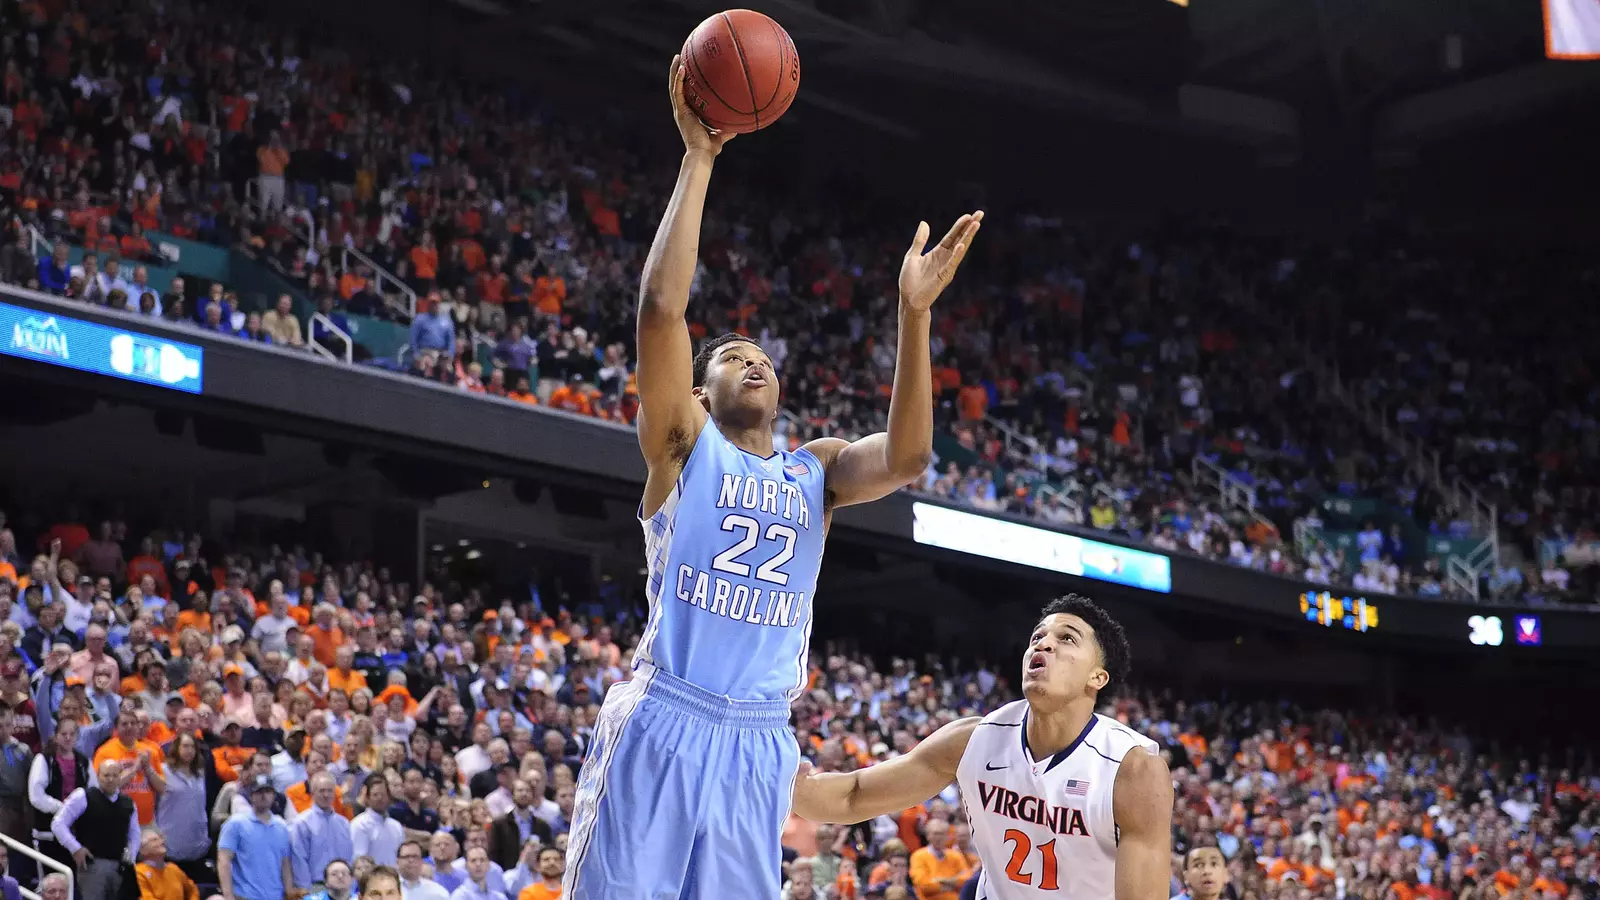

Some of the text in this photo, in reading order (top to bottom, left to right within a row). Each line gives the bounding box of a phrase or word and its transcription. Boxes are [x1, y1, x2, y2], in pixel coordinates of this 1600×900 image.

[716, 473, 810, 530] NORTH
[711, 513, 798, 586] 22
[675, 563, 805, 627] CAROLINA
[977, 780, 1091, 838] VIRGINIA
[1003, 828, 1060, 891] 21
